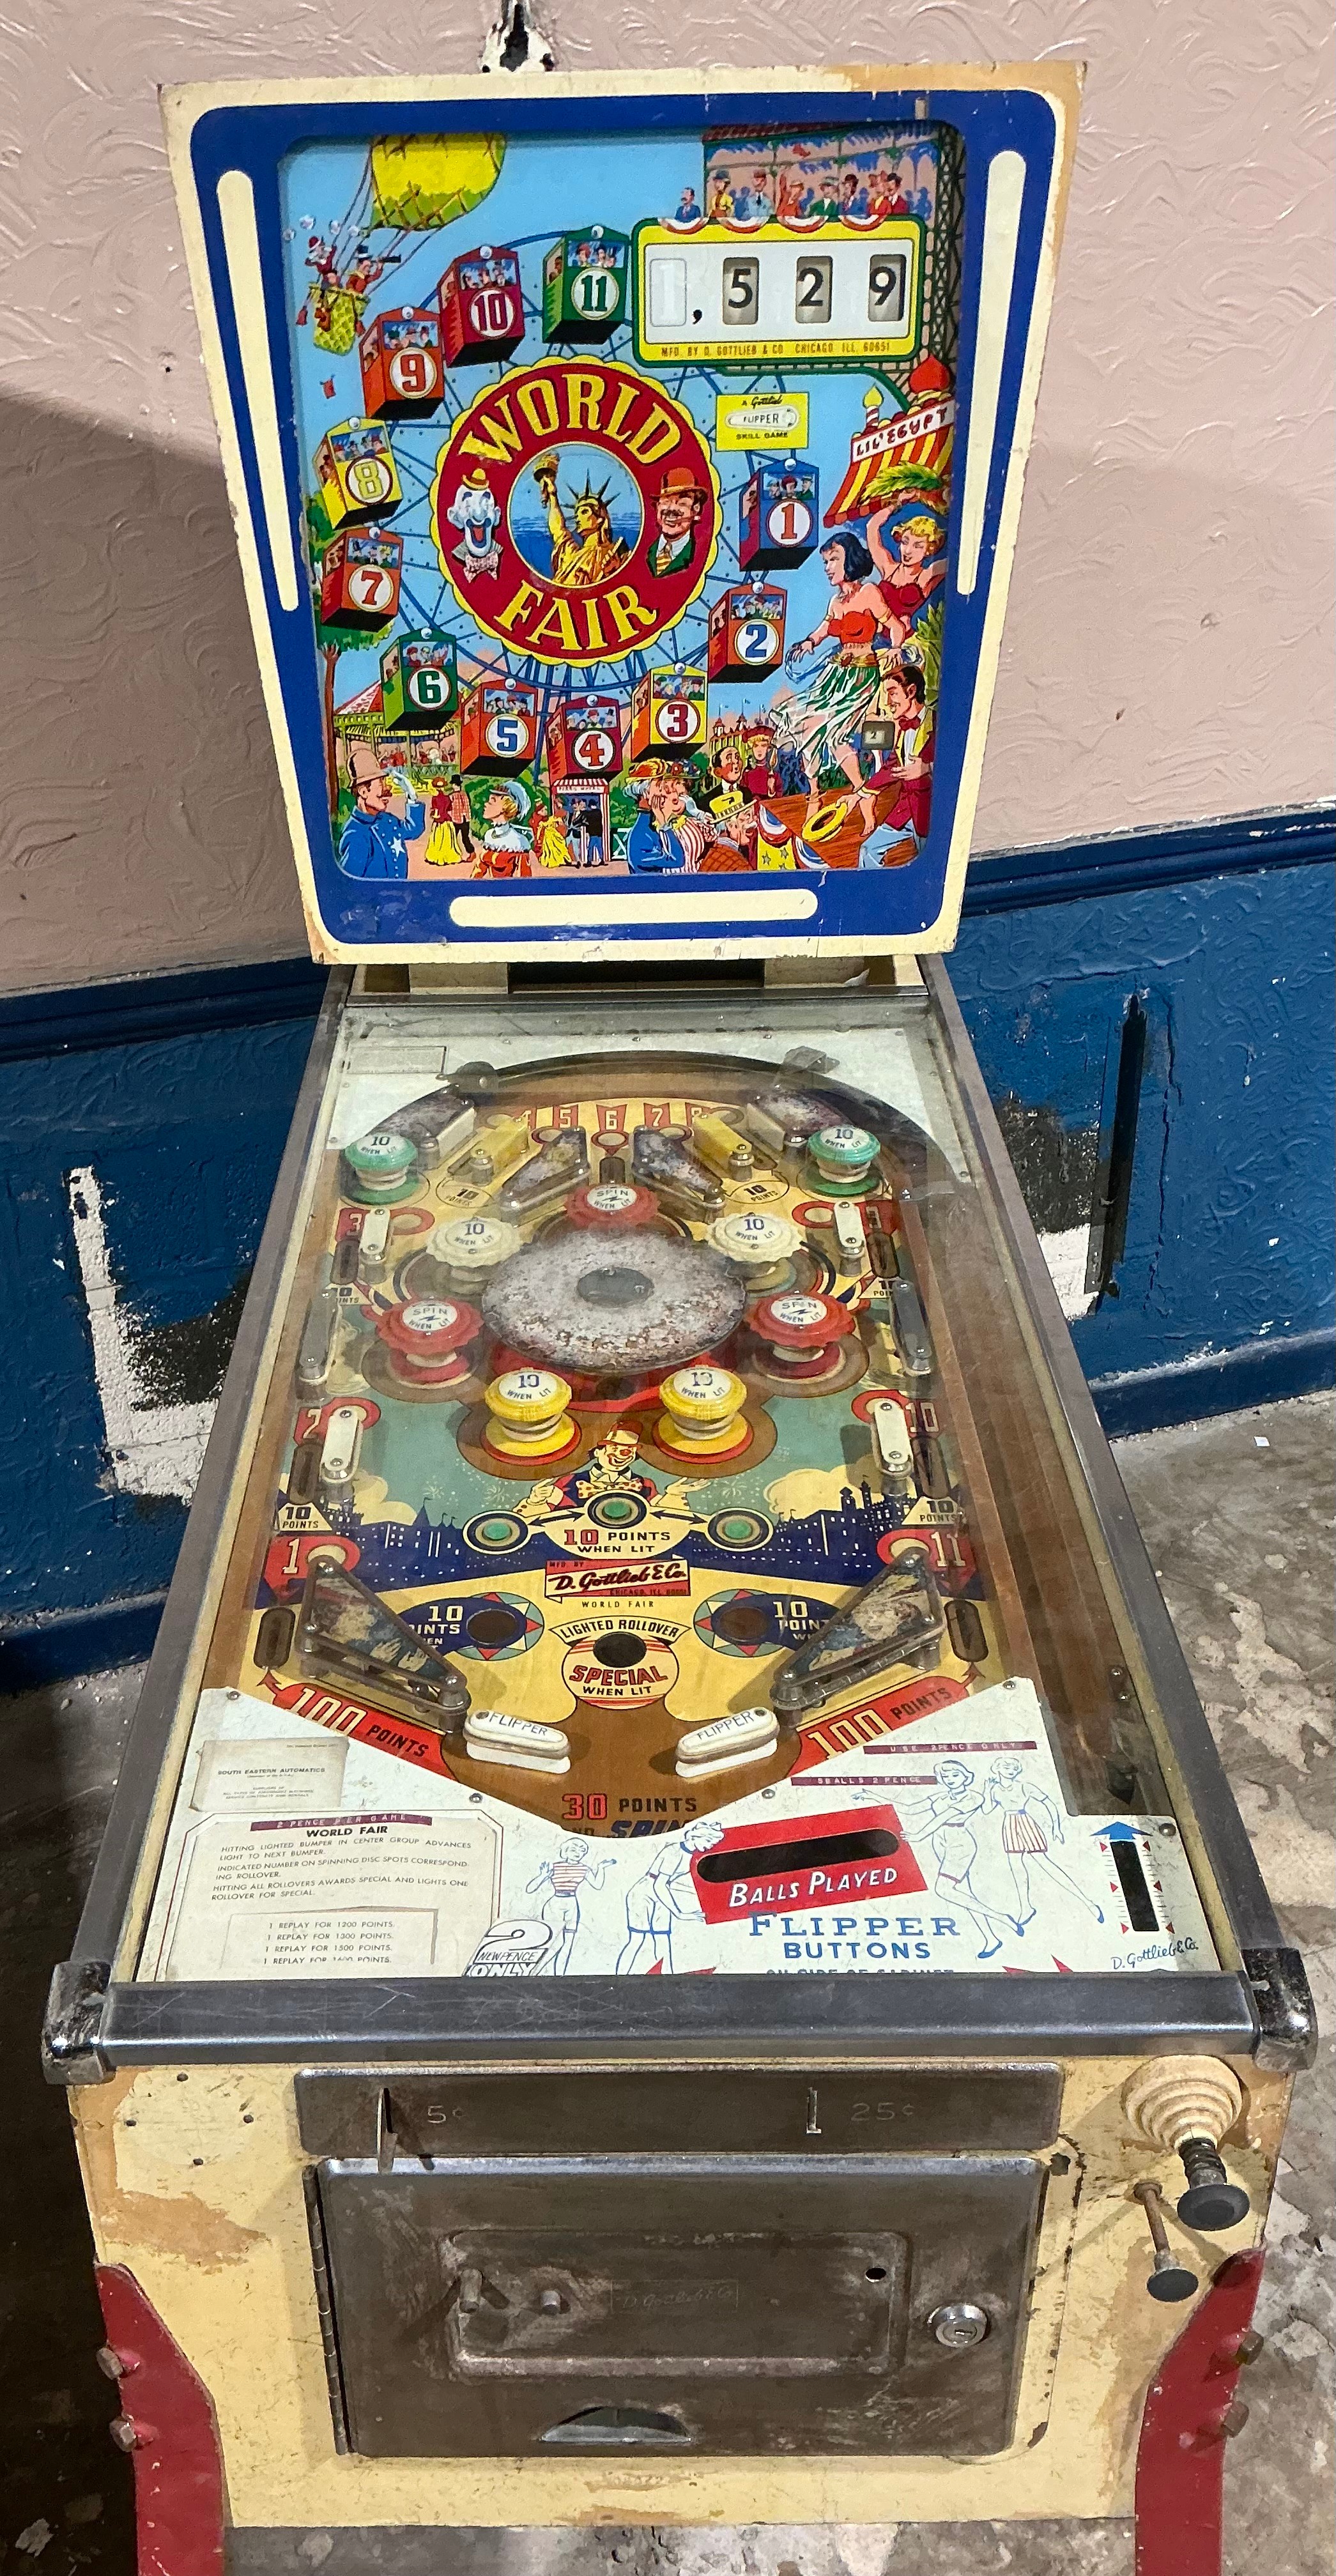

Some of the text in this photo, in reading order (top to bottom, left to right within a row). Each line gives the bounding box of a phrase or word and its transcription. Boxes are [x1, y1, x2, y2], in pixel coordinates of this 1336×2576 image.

[581, 275, 608, 312] 11
[475, 291, 510, 330] 10
[687, 346, 698, 356] BY
[717, 345, 756, 356] GOTTLIEB
[795, 342, 833, 353] CHICAGO
[401, 354, 426, 392] 9
[459, 374, 680, 463] WORLD
[354, 461, 383, 498] 8
[779, 503, 797, 540] 1
[360, 571, 383, 605] 7
[494, 580, 656, 650] FAIR
[745, 624, 768, 657] 2
[417, 671, 441, 703] 6
[667, 703, 689, 737] 3
[496, 720, 518, 751] 5
[579, 734, 604, 766] 4
[560, 1108, 572, 1128] 5
[605, 1110, 618, 1130] 6
[652, 1108, 664, 1126] 7
[371, 1137, 390, 1146] 10
[834, 1129, 853, 1139] 10
[744, 1185, 767, 1195] 10
[346, 1213, 362, 1236] 3
[465, 1223, 484, 1236] 10
[744, 1218, 764, 1230] 10
[413, 1307, 447, 1315] SPIN
[905, 1402, 940, 1432] 10
[286, 1506, 311, 1520] 10
[926, 1500, 954, 1514] 10
[282, 1521, 319, 1529] POINTS
[564, 1529, 670, 1545] 10 POINTS
[282, 1537, 300, 1574] 1
[930, 1531, 966, 1567] 11
[548, 1565, 650, 1593] D. Gottlieb
[427, 1606, 463, 1621] 10
[772, 1601, 808, 1618] 10
[560, 1620, 680, 1638] LIGHTED ROLLOVER
[569, 1665, 668, 1687] SPECIAL
[583, 1685, 651, 1696] WHEN LIT
[289, 1687, 429, 1757] 100 POINTS
[489, 1712, 548, 1736] FLIPPER
[697, 1710, 755, 1740] FLIPPER
[808, 1687, 953, 1760] 100 POINTS
[981, 1742, 1017, 1751] ONLY
[562, 1793, 697, 1820] 30 POINTS
[307, 1825, 388, 1837] WORLD FAIR
[426, 1839, 472, 1848] ADVANCES
[318, 1857, 359, 1865] SPINNING
[268, 1880, 315, 1889] ROLLOVERS
[318, 1878, 355, 1886] AWARDS
[729, 1867, 898, 1908] BALLS PLAYED
[211, 1892, 254, 1901] ROLLOVER
[748, 1912, 960, 1936] FLIPPER
[783, 1942, 930, 1959] BUTTONS
[1110, 1942, 1176, 1970] D. Gottlieb
[470, 1963, 538, 1977] ONLY
